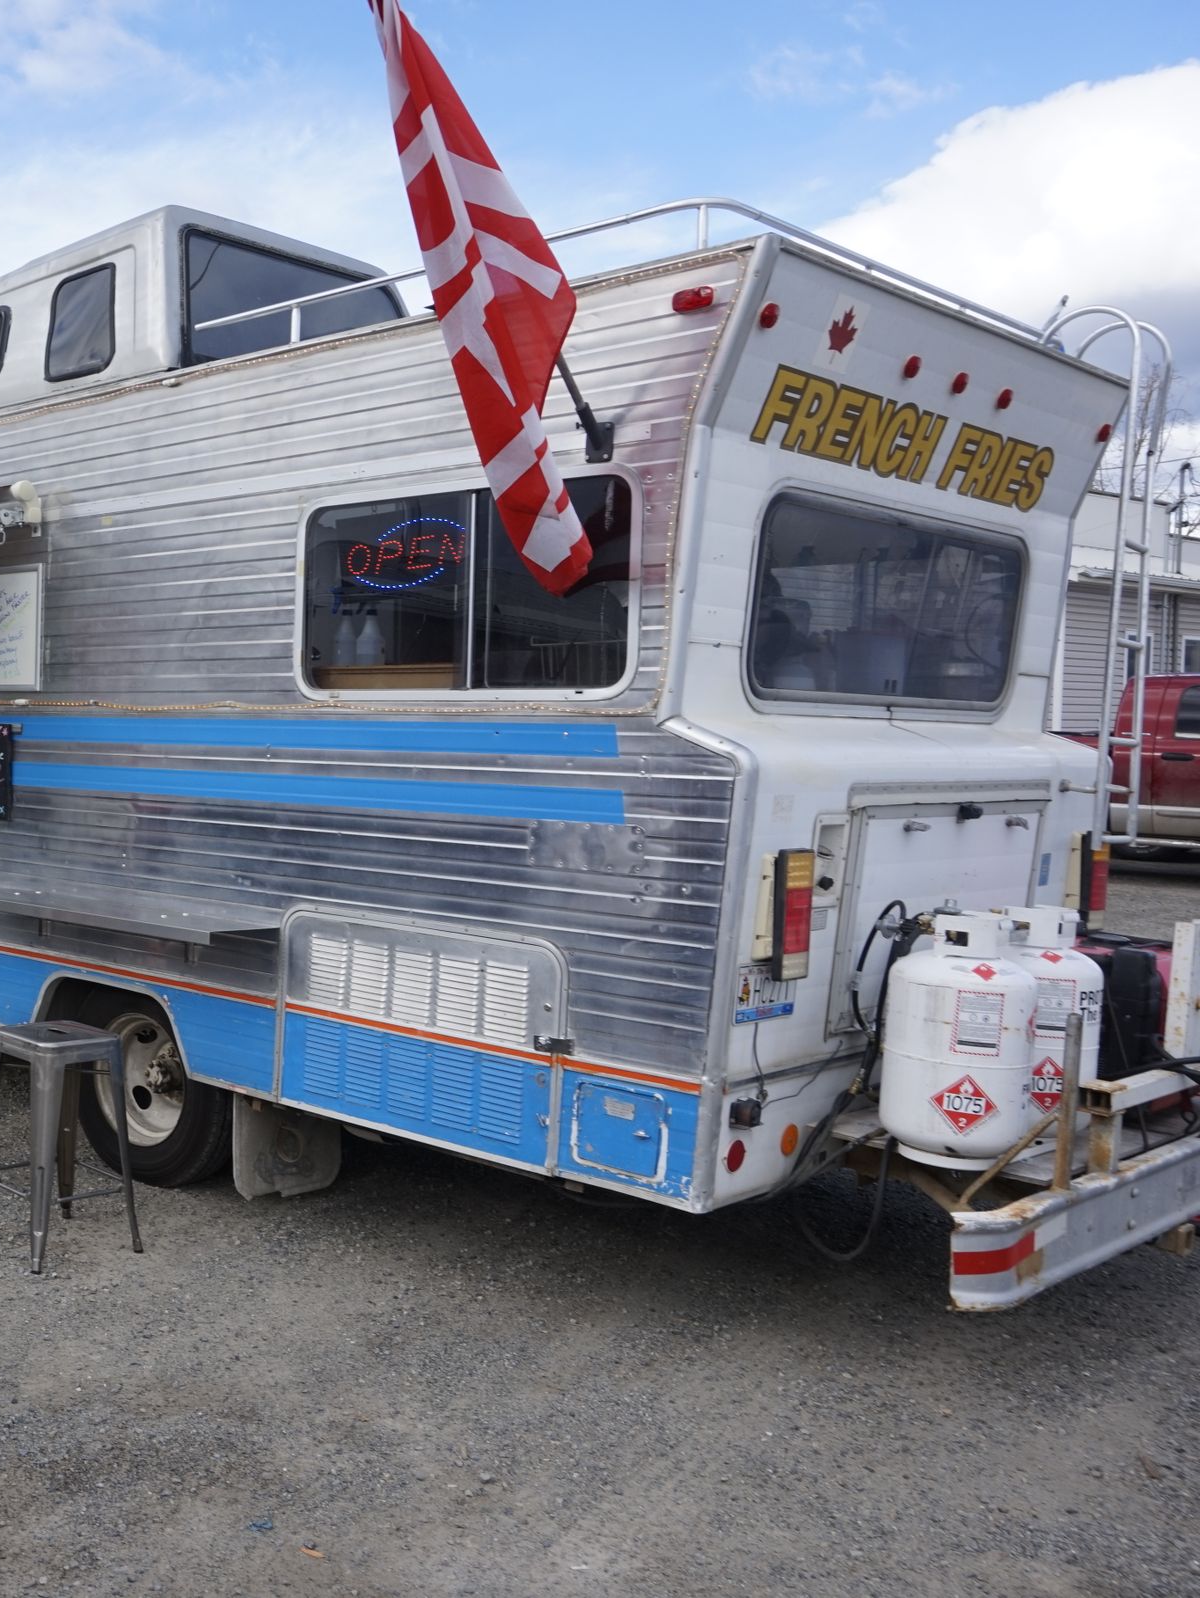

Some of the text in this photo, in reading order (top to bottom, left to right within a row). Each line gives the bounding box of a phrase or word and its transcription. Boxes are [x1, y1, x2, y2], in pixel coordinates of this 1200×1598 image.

[751, 363, 1054, 513] FRENCH FRIES
[346, 532, 466, 576] OPEN
[1032, 1077, 1064, 1092] 1075
[945, 1094, 984, 1114] 1075
[1044, 1097, 1053, 1107] 2
[957, 1117, 968, 1128] 2
